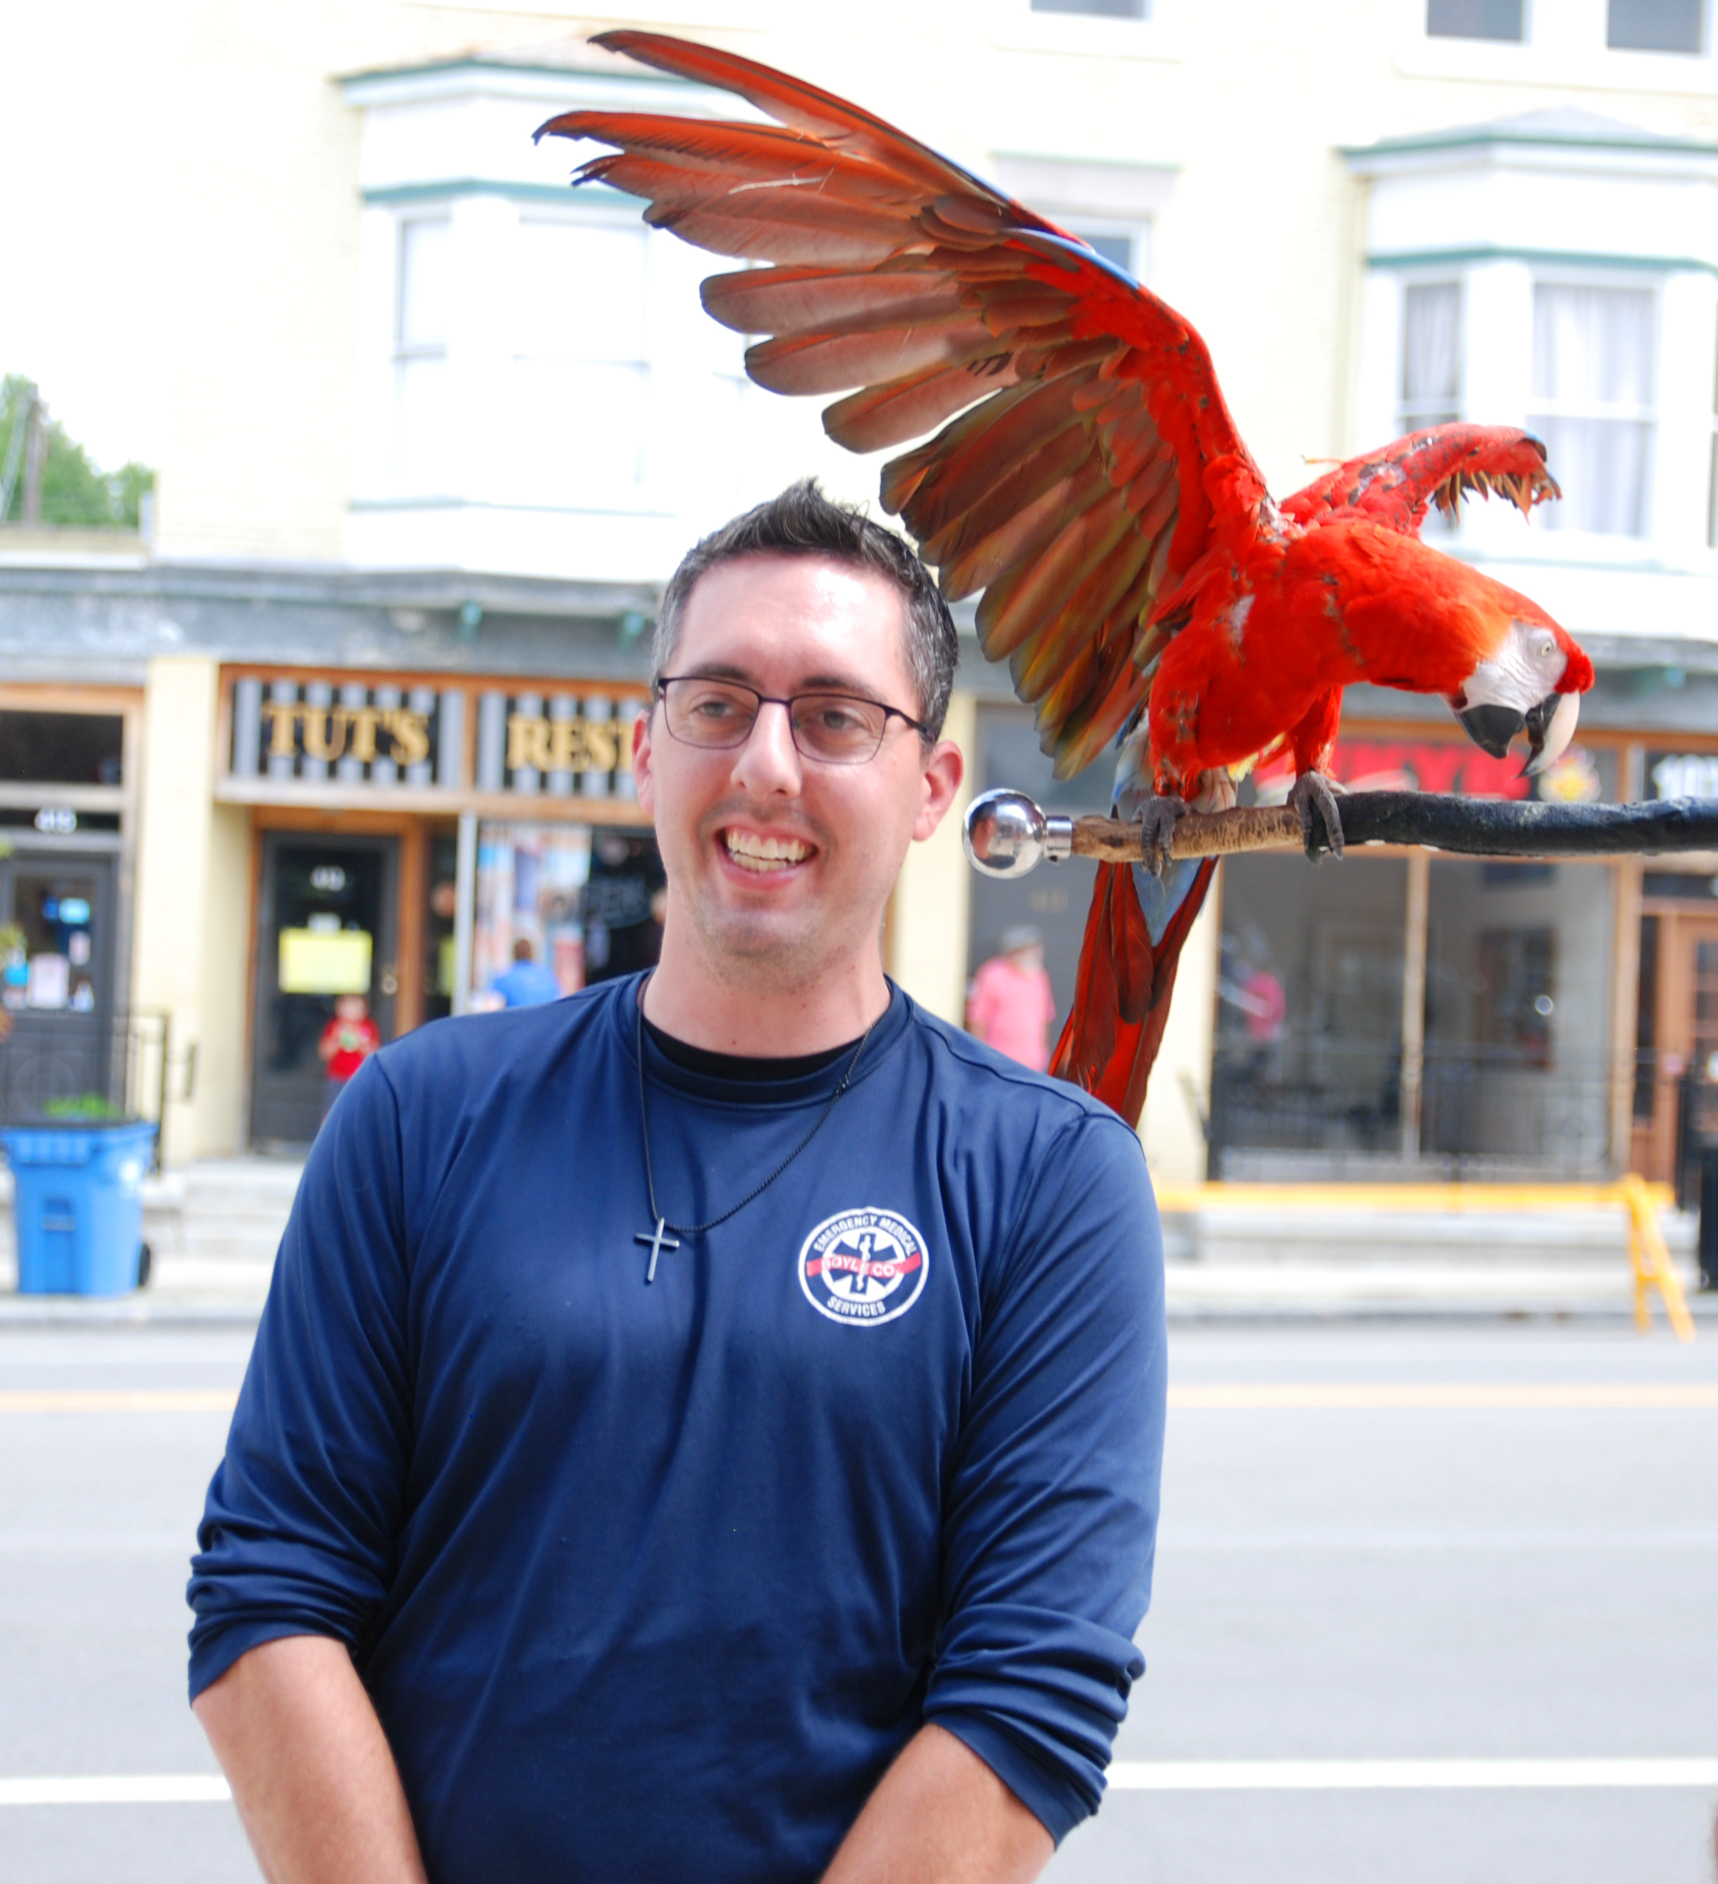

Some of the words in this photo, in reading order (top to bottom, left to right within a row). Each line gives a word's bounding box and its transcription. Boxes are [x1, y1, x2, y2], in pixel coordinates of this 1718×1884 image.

[265, 704, 431, 766] TUT'S
[813, 1215, 878, 1252] EMERGENCY
[879, 1217, 917, 1256] MEDICAL
[827, 1296, 886, 1317] SERVICES
